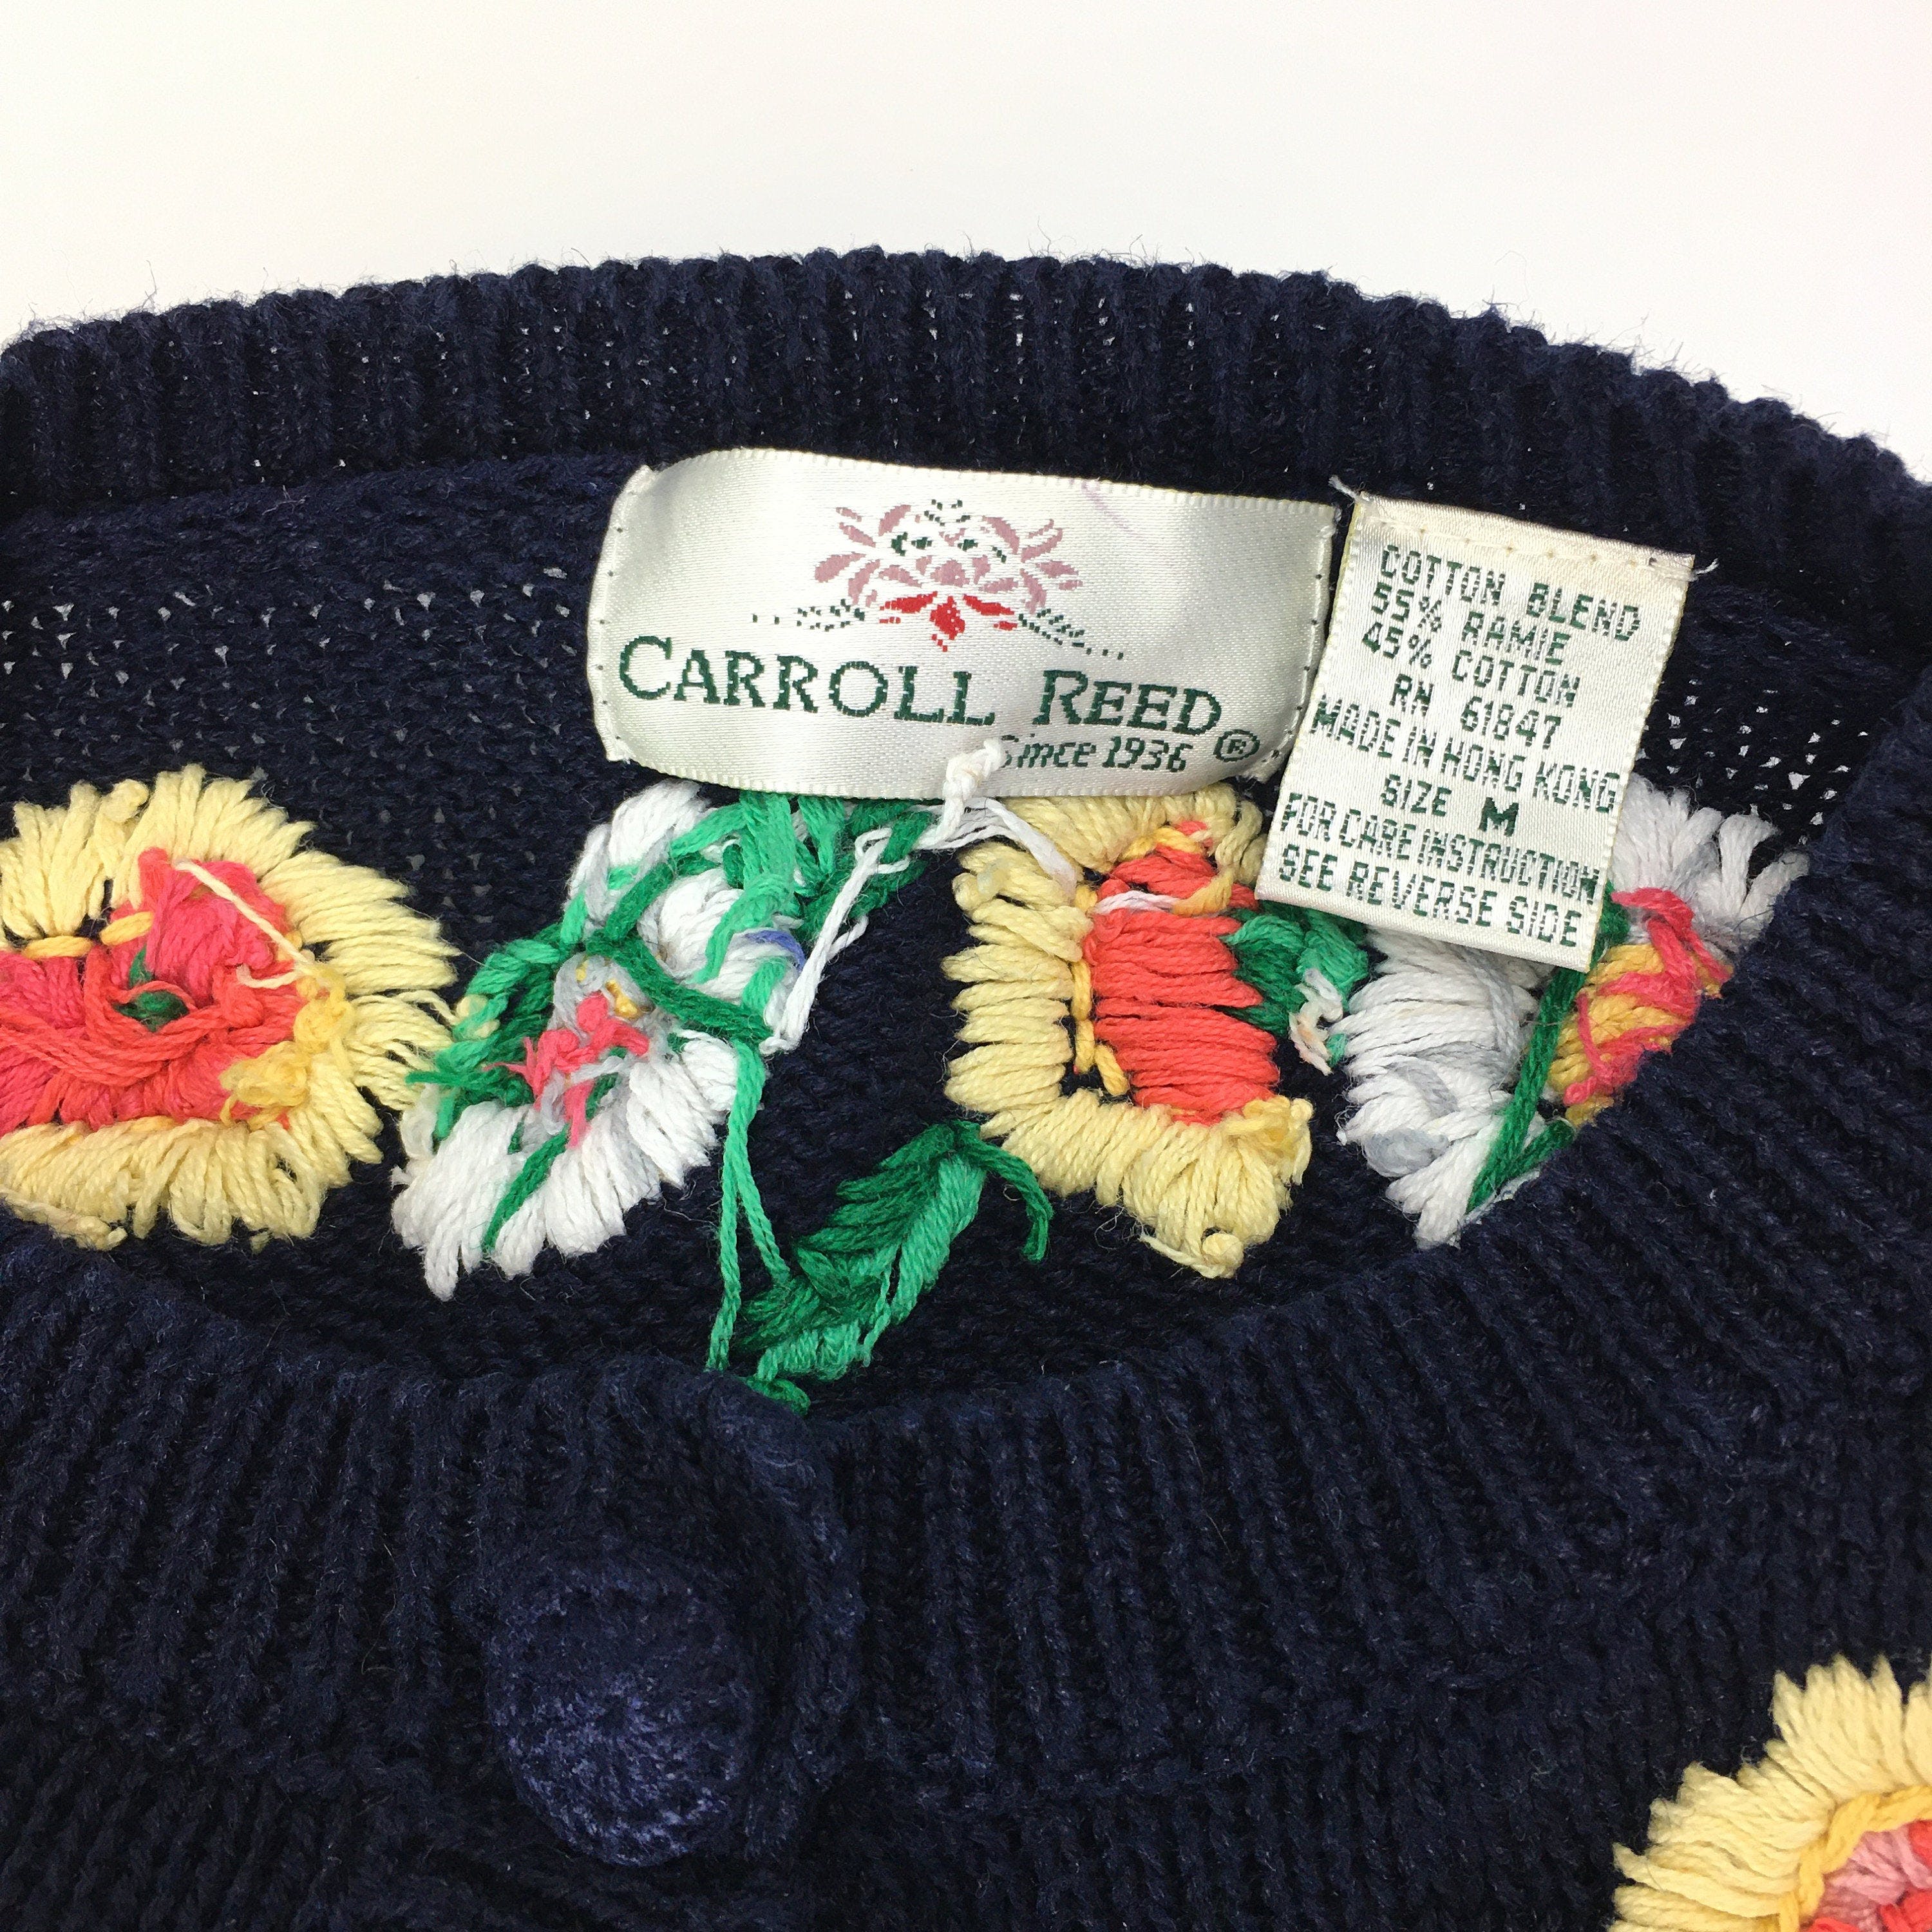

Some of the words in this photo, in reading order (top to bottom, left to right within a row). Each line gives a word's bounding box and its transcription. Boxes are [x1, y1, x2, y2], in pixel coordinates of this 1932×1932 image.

[1371, 582, 1442, 633] 55%
[1461, 611, 1570, 665] RAMIE
[1381, 544, 1506, 605] COTTON
[1526, 582, 1640, 641] BLEND
[620, 635, 994, 726] CARROLL
[1040, 669, 1222, 735] REED
[1362, 622, 1431, 669] 45%
[1452, 650, 1580, 707] COTTON
[1103, 735, 1194, 772] 1936
[1309, 694, 1400, 758] MADE
[1403, 726, 1436, 768] IN
[1441, 737, 1525, 791] HONG
[1533, 761, 1620, 813] KONG
[1390, 673, 1434, 715] RN
[1461, 697, 1561, 750] 61847
[1280, 793, 1336, 841] FOR
[1340, 810, 1416, 860] CARE
[1417, 828, 1599, 904] INSTRUCTION
[1380, 773, 1452, 817] SIZE
[1478, 797, 1519, 837] M
[1279, 845, 1338, 891] SEE
[1346, 861, 1497, 927] REVERSE
[1507, 896, 1582, 947] SIDE
